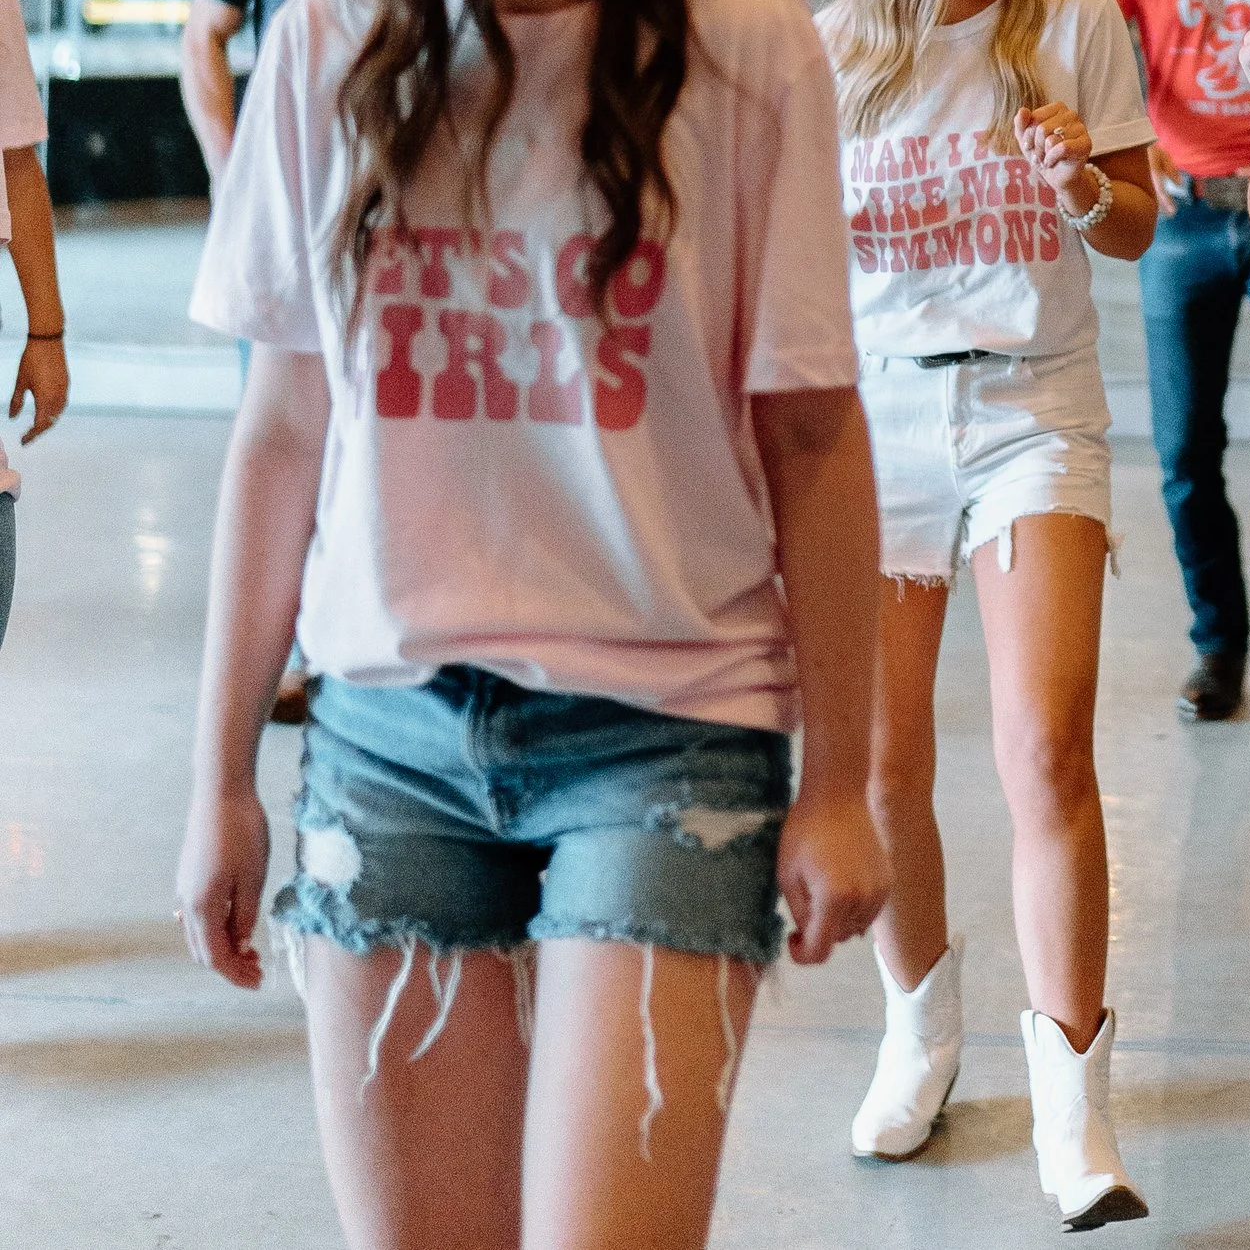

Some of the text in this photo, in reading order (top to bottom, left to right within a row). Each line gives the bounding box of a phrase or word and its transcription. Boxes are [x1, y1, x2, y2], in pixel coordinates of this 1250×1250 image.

[851, 136, 936, 182] MAN,
[948, 132, 961, 166] I
[370, 228, 526, 308] ET'S
[853, 211, 1061, 274] SIMMONS
[376, 304, 651, 431] IRLS
